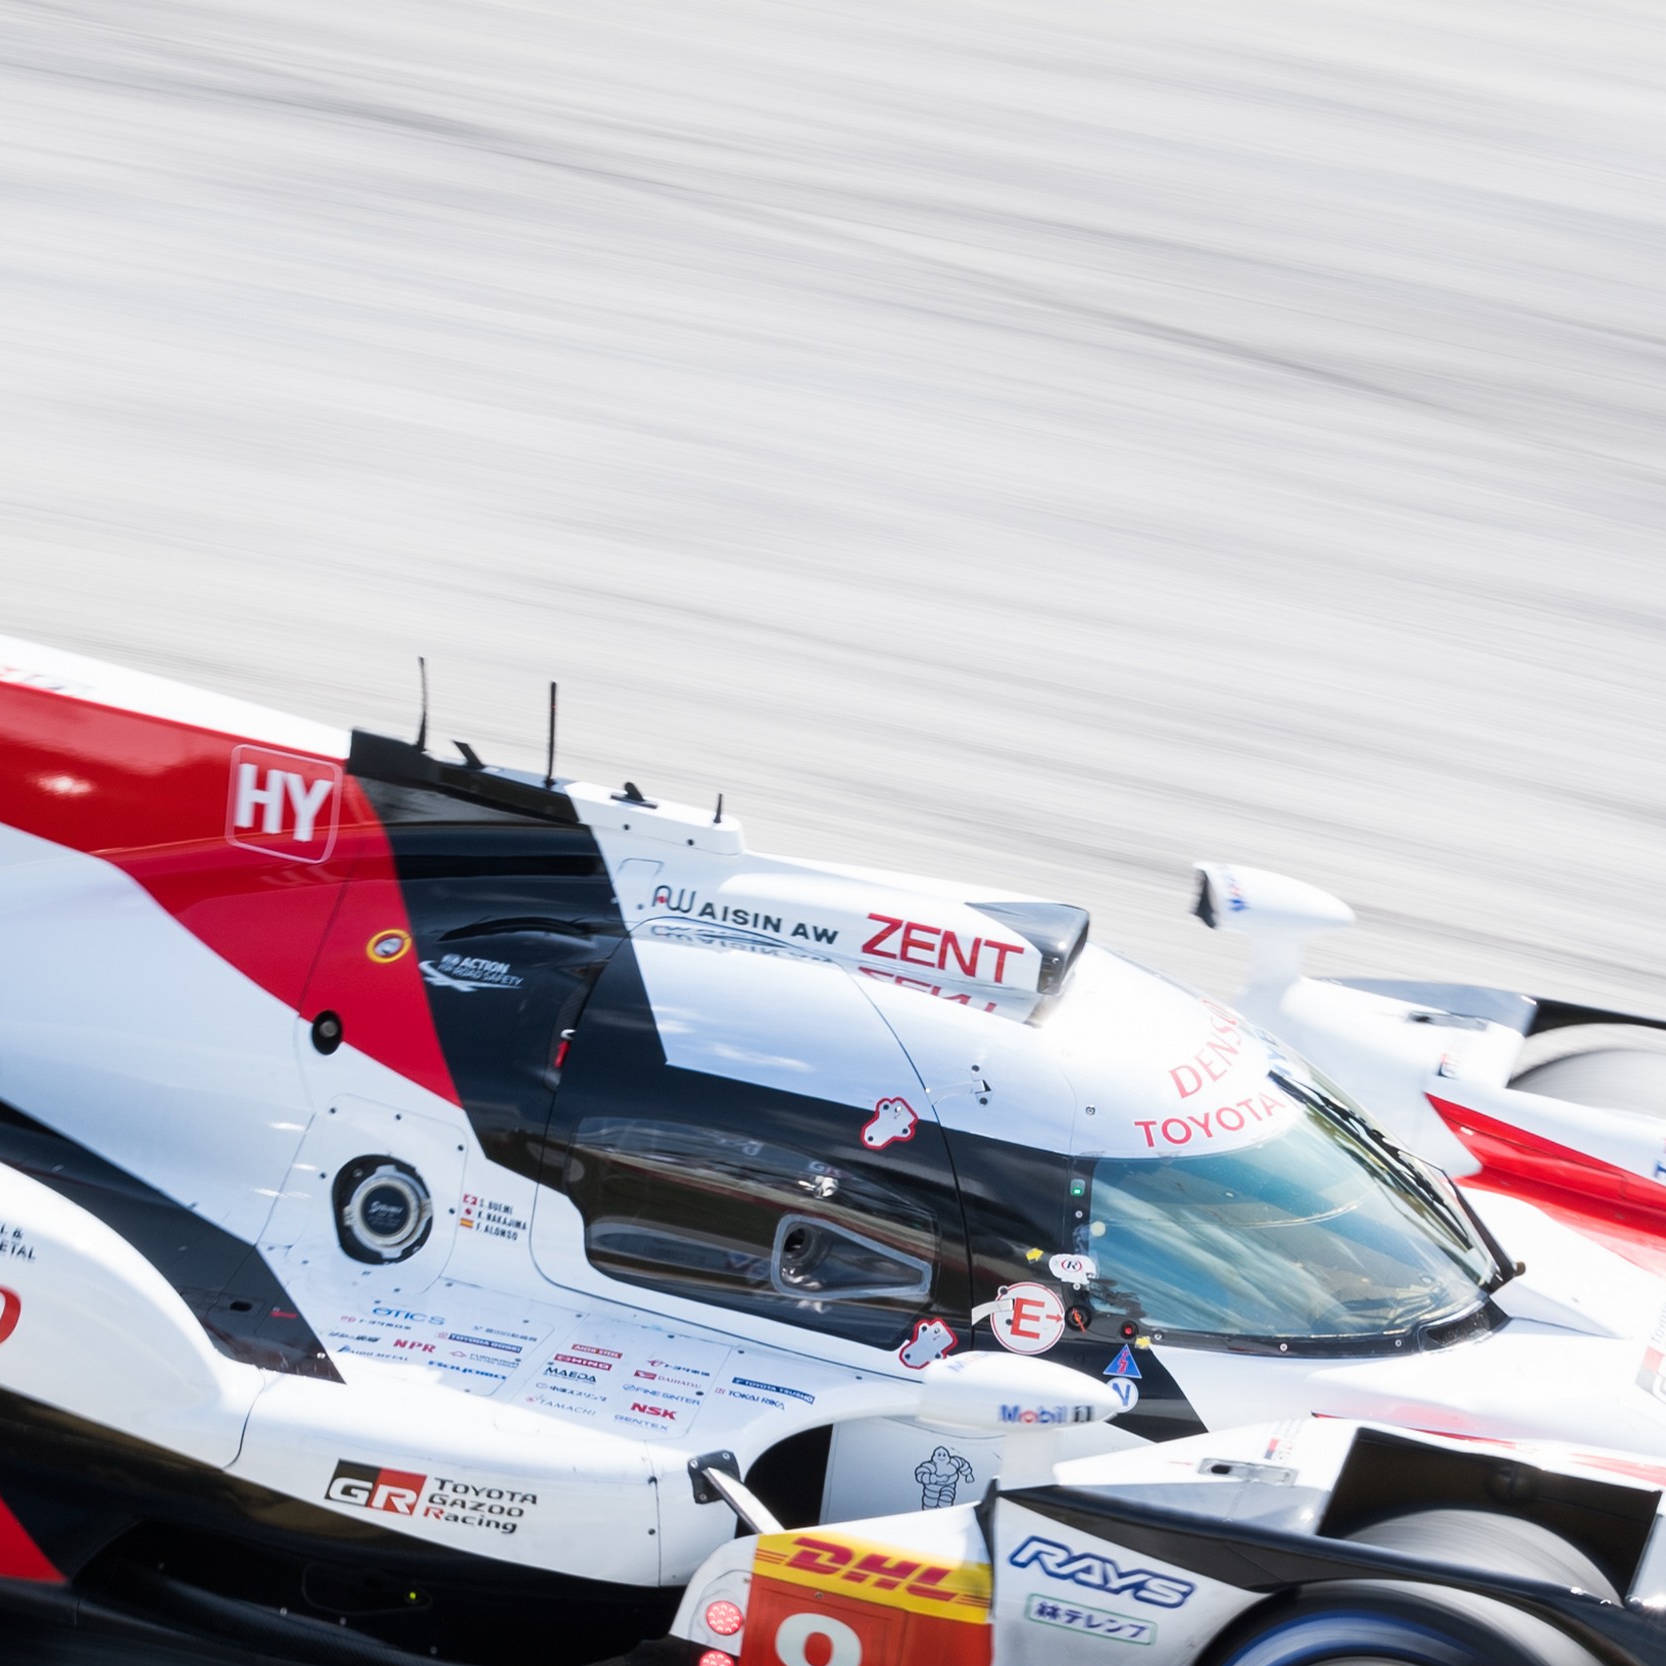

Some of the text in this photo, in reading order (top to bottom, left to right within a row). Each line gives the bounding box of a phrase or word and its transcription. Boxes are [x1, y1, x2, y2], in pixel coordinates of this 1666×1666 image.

[234, 762, 334, 843] HY
[697, 901, 783, 934] AISIN
[789, 922, 840, 946] AW
[860, 911, 1025, 985] ZENT
[459, 956, 512, 974] ACTION
[1133, 1091, 1287, 1149] TOYOTA
[488, 1200, 514, 1216] BUEMI
[486, 1211, 528, 1231] NAKAJIMA
[12, 1226, 24, 1240] &
[483, 1223, 519, 1242] ALONSO
[372, 1306, 446, 1327] OTICS
[1010, 1297, 1046, 1340] E
[392, 1338, 437, 1354] NPR
[570, 1356, 611, 1370] HINO
[545, 1366, 597, 1383] MAEDA
[657, 1374, 702, 1389] DAIHATSU
[634, 1385, 701, 1407] FINE SINTER
[728, 1389, 785, 1411] TOKAI RIKA
[744, 1380, 814, 1404] TOYOTA TSUSHO
[538, 1398, 597, 1417] TAMACHI
[630, 1402, 677, 1421] NSK
[998, 1403, 1066, 1425] Mobil
[614, 1413, 669, 1432] GENTEX
[328, 1476, 538, 1515] GR TOYOTA
[428, 1492, 525, 1519] GAZOO
[423, 1506, 518, 1535] Racing
[785, 1536, 957, 1602] DHL
[1009, 1534, 1197, 1609] RAYS
